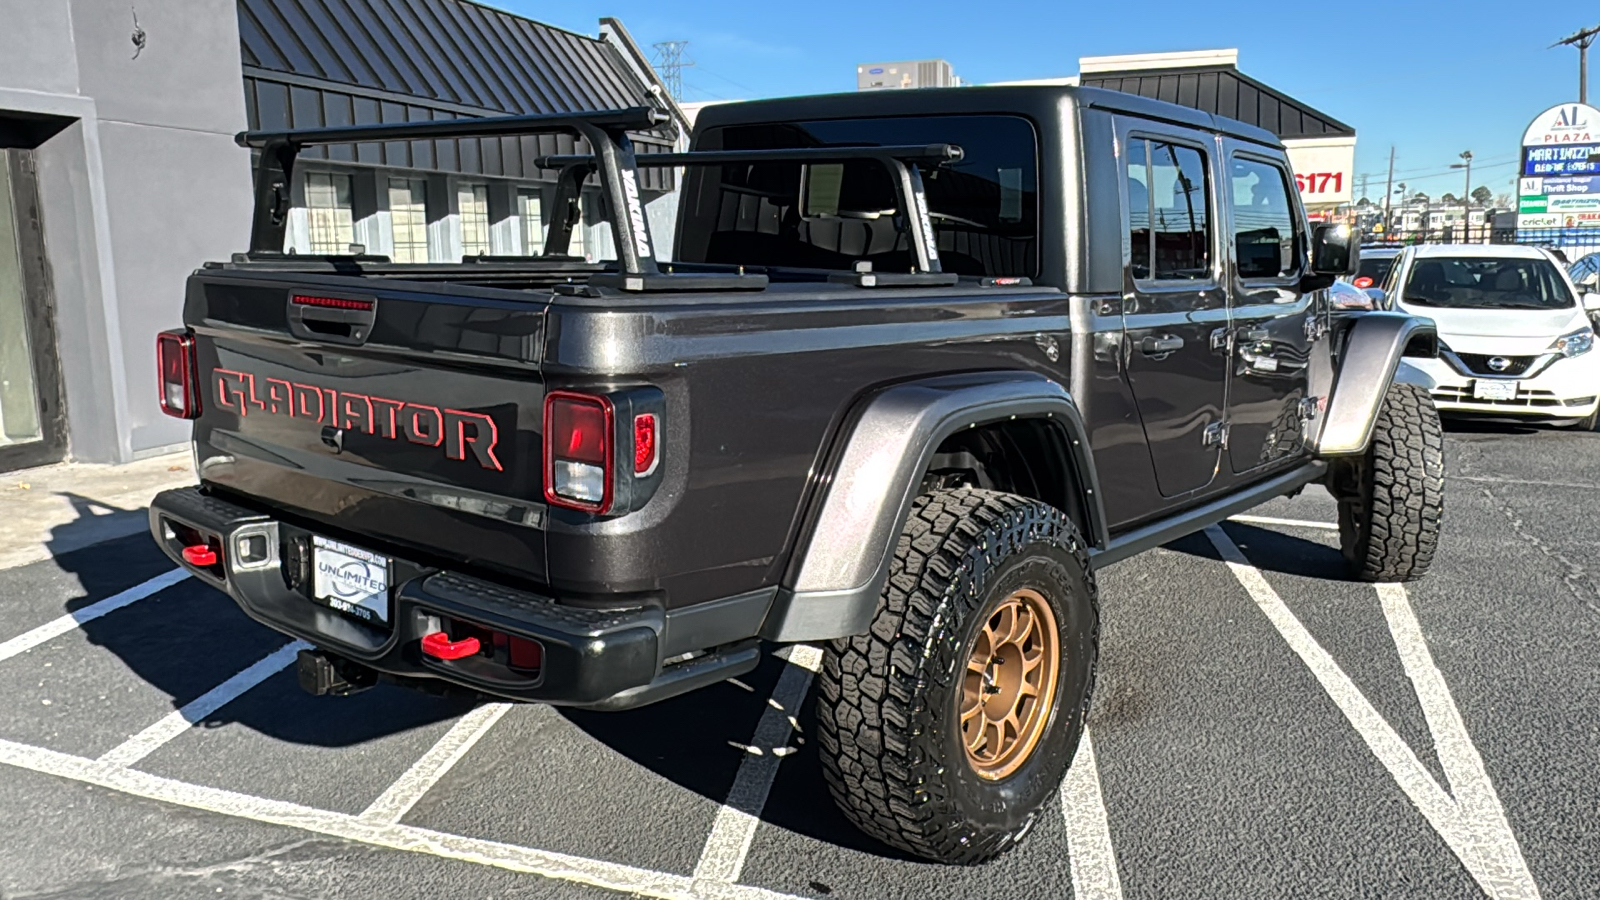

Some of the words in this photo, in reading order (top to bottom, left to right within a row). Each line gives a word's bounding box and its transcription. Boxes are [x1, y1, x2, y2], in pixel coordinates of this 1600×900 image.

[1544, 133, 1591, 143] PLAZA
[1295, 171, 1342, 193] 6171
[1543, 185, 1564, 193] Thrift
[1566, 184, 1588, 193] Shop
[621, 169, 651, 257] YAKIMA
[1522, 217, 1557, 226] cricket
[211, 367, 504, 472] GLADIATOR
[318, 562, 387, 593] UNLIMITED
